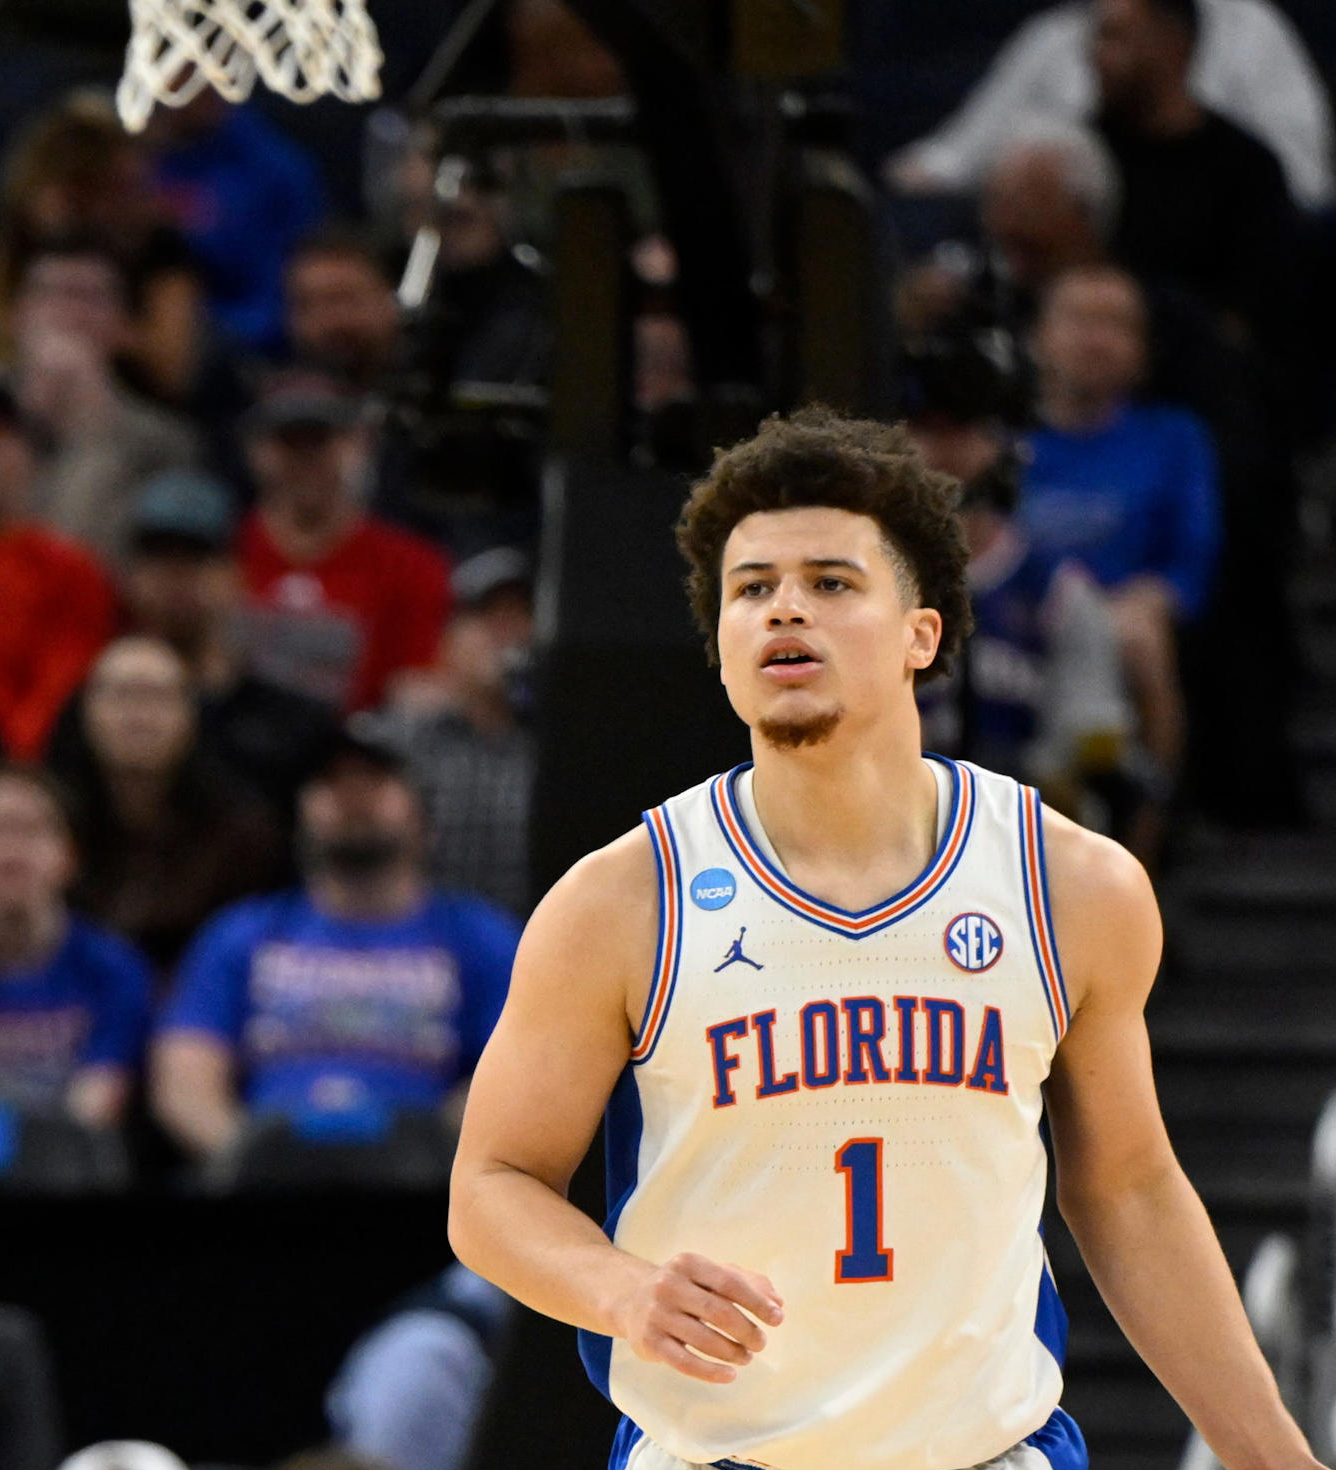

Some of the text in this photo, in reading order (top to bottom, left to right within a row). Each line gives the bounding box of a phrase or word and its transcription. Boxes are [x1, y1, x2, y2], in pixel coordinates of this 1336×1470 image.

[695, 886, 734, 900] NCAA
[948, 915, 1000, 970] SEC
[706, 996, 1009, 1109] FLORIDA
[834, 1137, 894, 1284] 1
